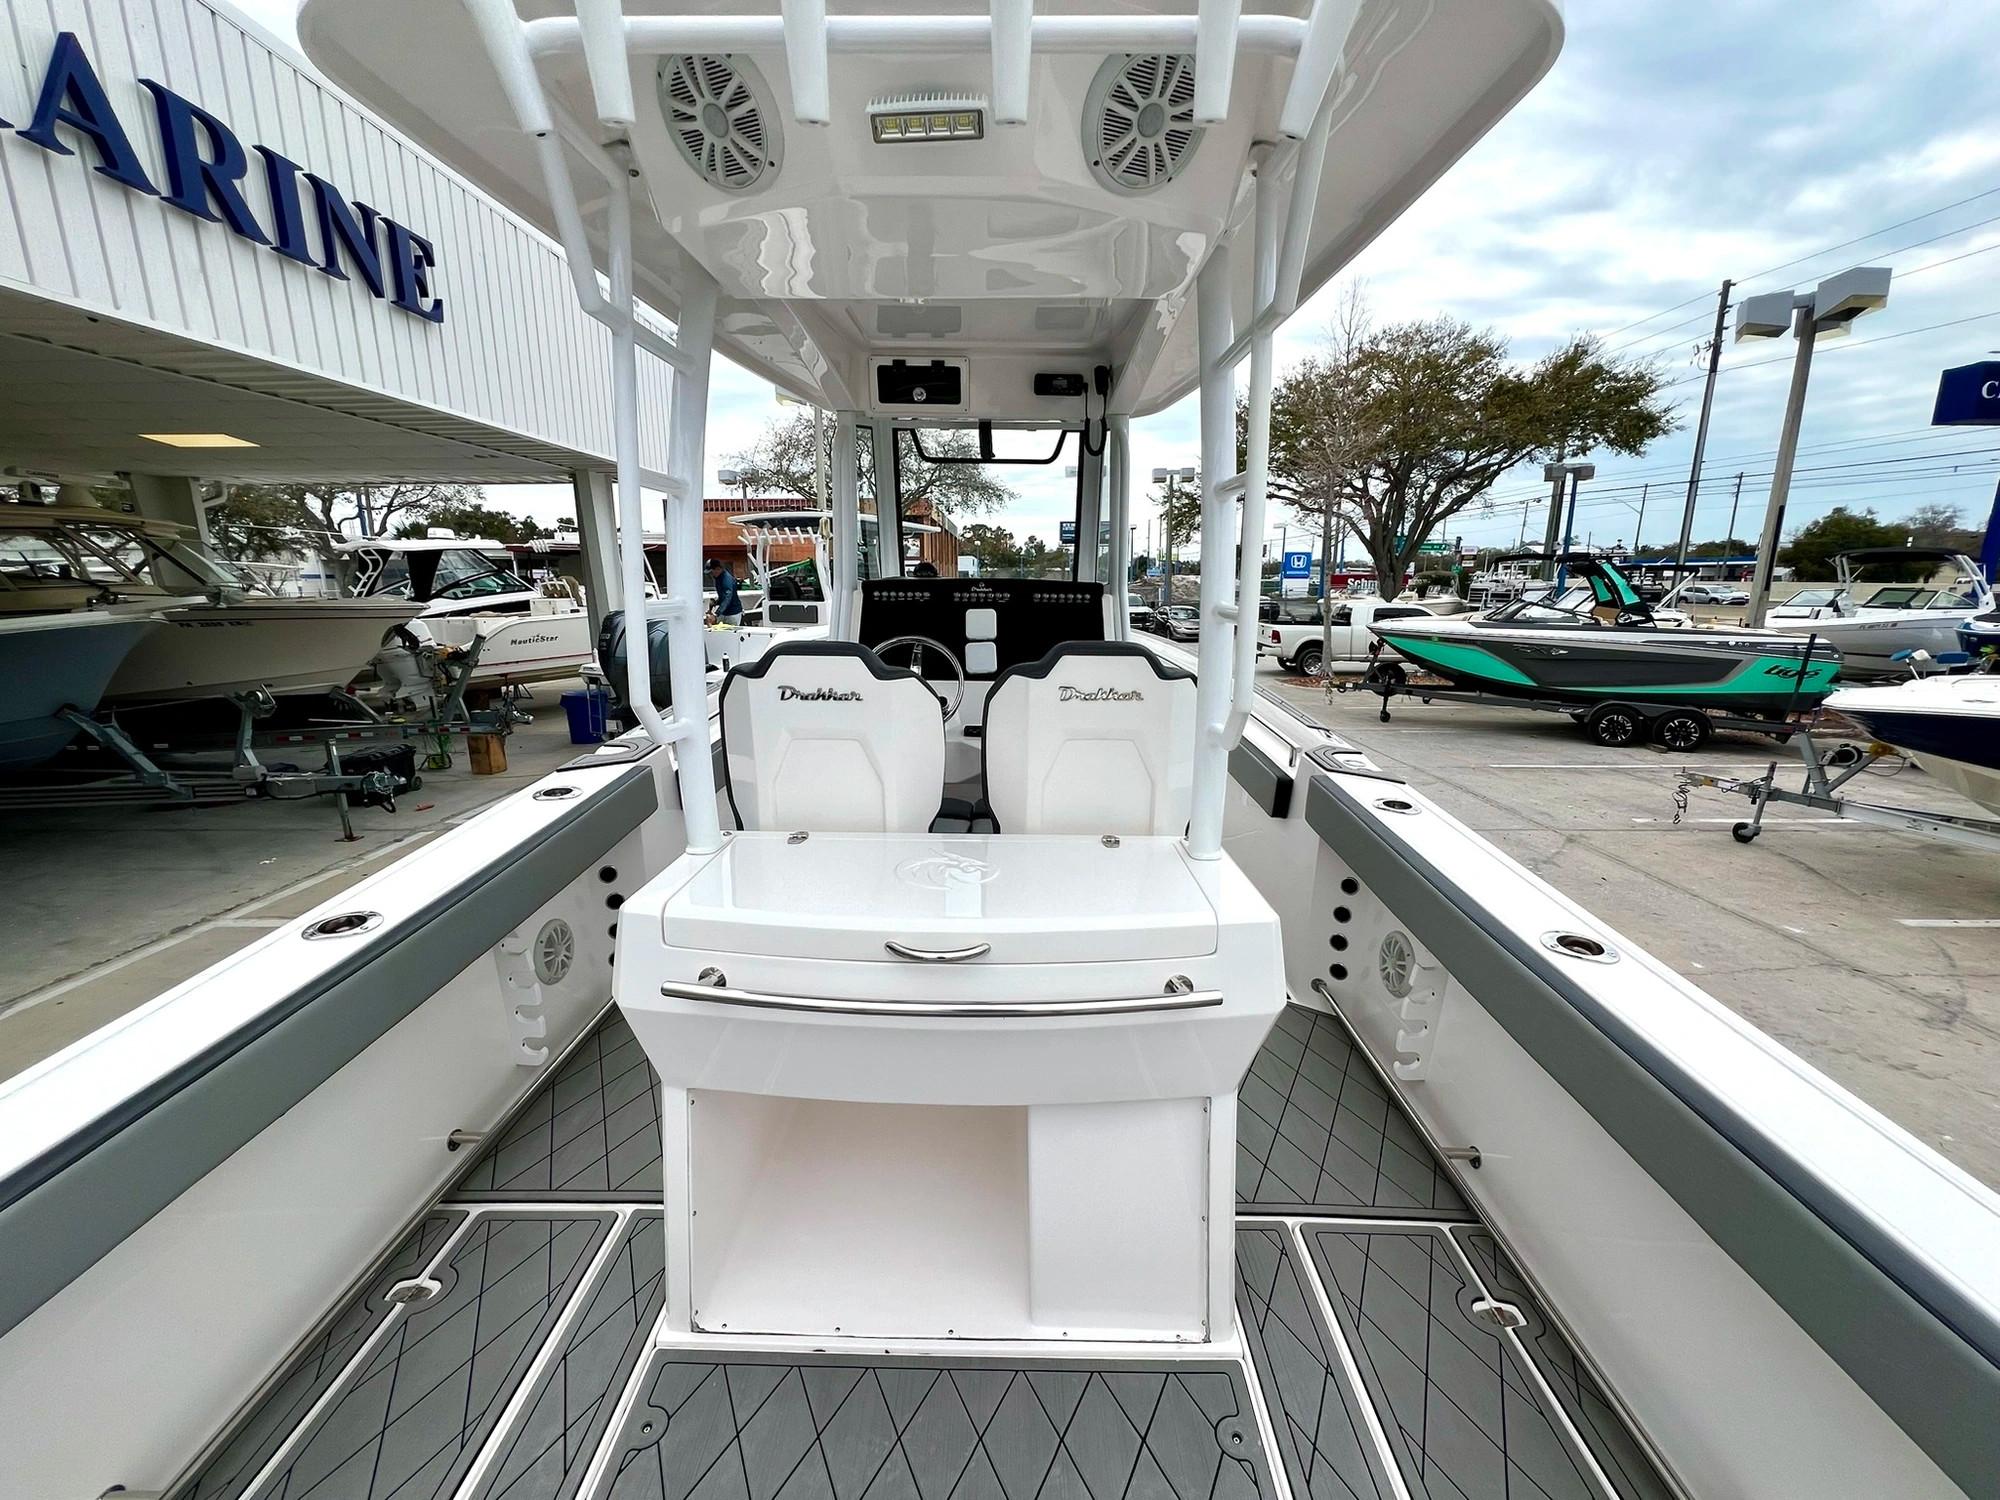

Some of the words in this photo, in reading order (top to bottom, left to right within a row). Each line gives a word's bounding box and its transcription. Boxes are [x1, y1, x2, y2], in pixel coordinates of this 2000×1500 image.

[0, 32, 444, 323] ARINE
[1982, 381, 2000, 399] C
[510, 634, 559, 645] NauticStar
[778, 686, 863, 701] Drakkar
[1059, 686, 1144, 701] Drakkar
